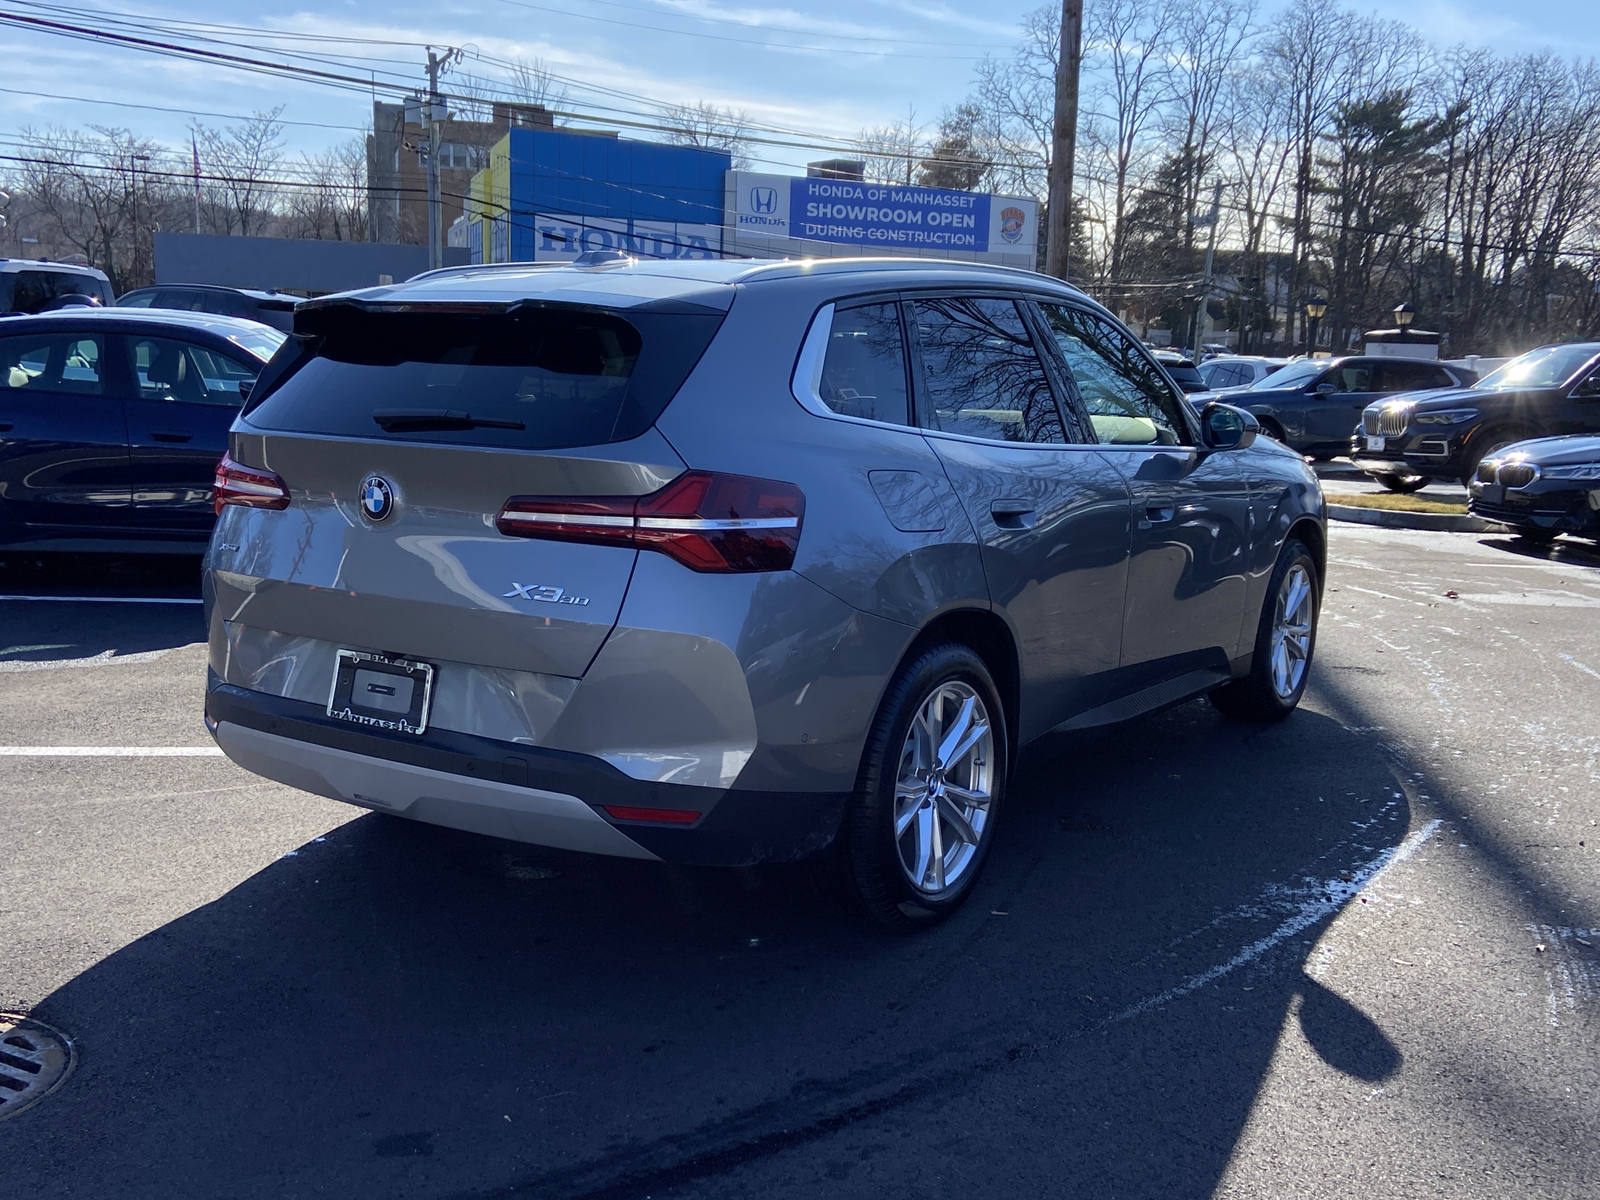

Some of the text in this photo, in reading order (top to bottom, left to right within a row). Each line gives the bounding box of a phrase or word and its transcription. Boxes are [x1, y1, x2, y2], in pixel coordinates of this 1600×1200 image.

[808, 183, 976, 209] HONDA OF MANHASSET
[739, 215, 787, 228] HONDA
[806, 202, 976, 229] SHOWROOM OPEN
[538, 226, 714, 260] HONDA
[805, 223, 976, 246] DURING CONSTRUCTION
[362, 478, 390, 495] BMW
[330, 710, 419, 734] MANHASSET
